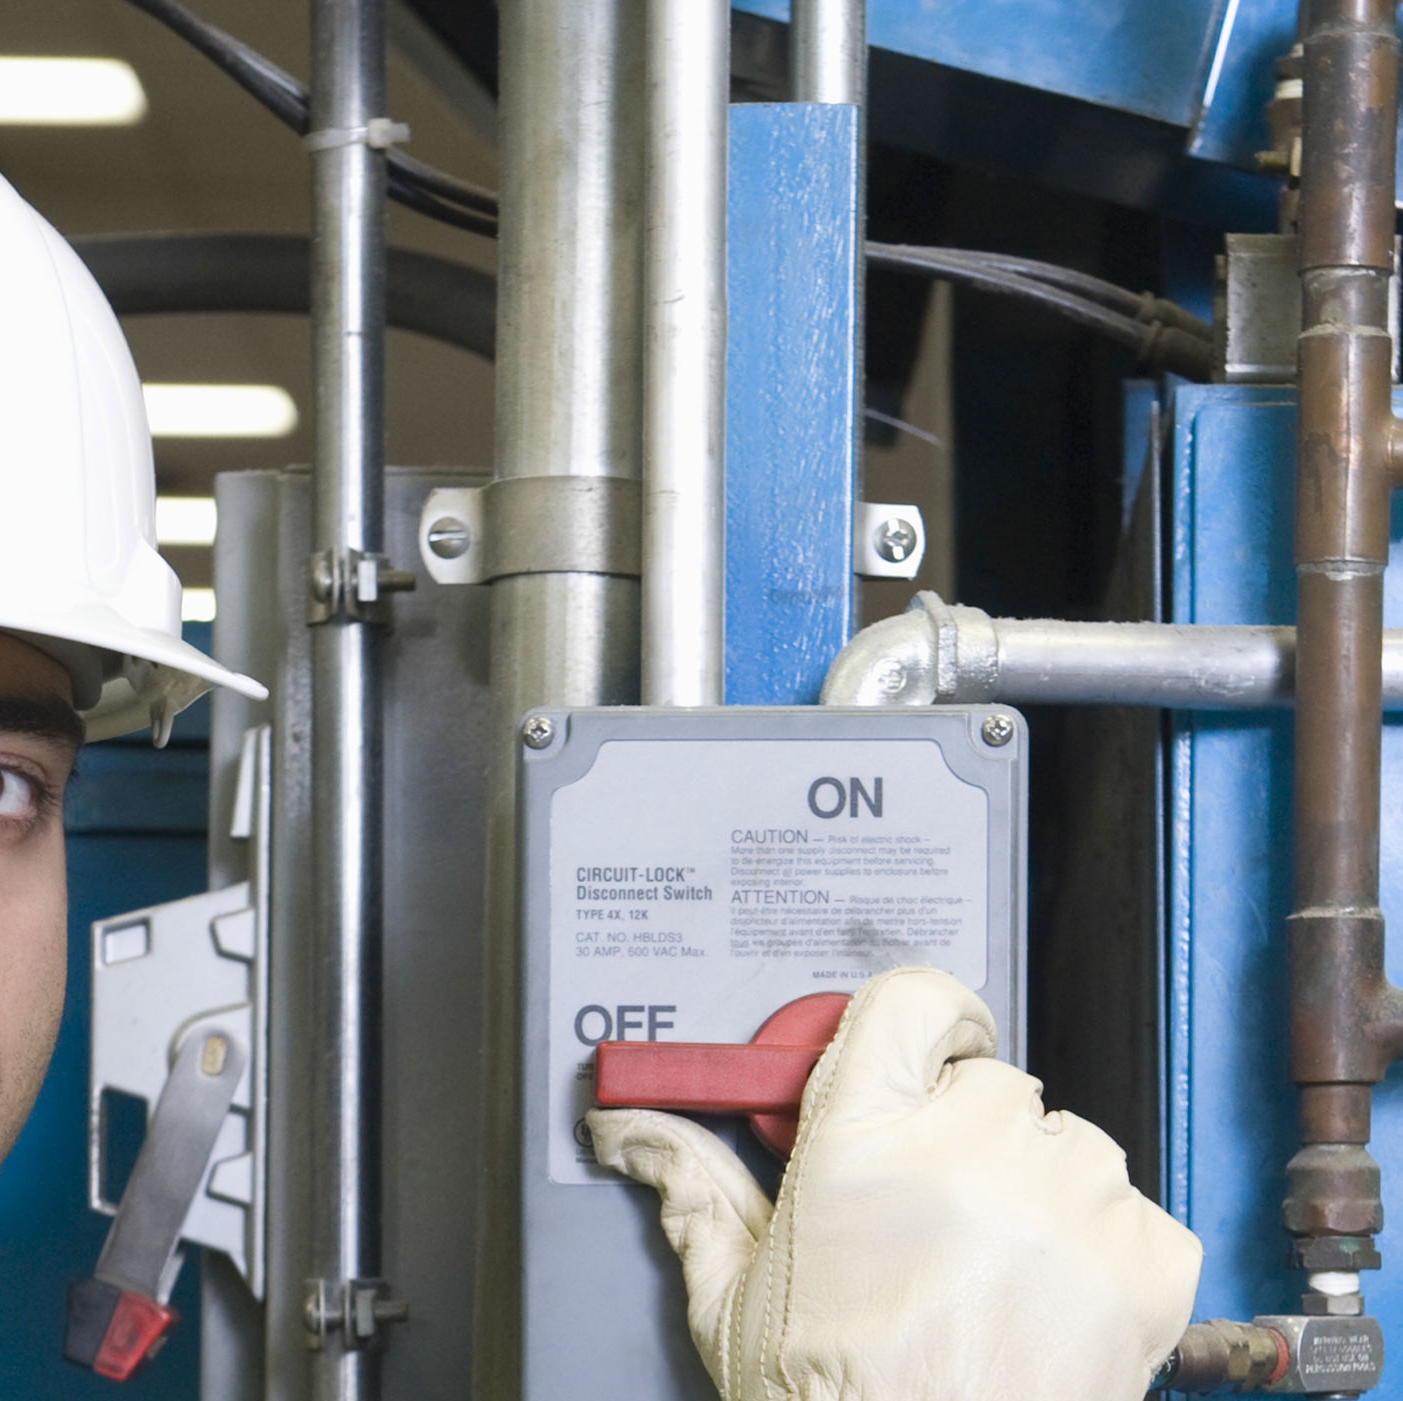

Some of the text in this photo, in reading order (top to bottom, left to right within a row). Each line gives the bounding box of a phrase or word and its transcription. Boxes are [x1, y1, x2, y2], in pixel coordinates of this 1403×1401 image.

[807, 777, 883, 819] ON
[731, 829, 808, 844] CAUTION
[577, 885, 712, 900] Disconnect Switch
[731, 890, 829, 904] ATTENTION
[576, 909, 604, 920] TYPE
[629, 909, 648, 920] 12K
[576, 946, 590, 957] 30
[627, 946, 649, 957] 600
[652, 946, 678, 957] VAC
[574, 1004, 677, 1047] OFF
